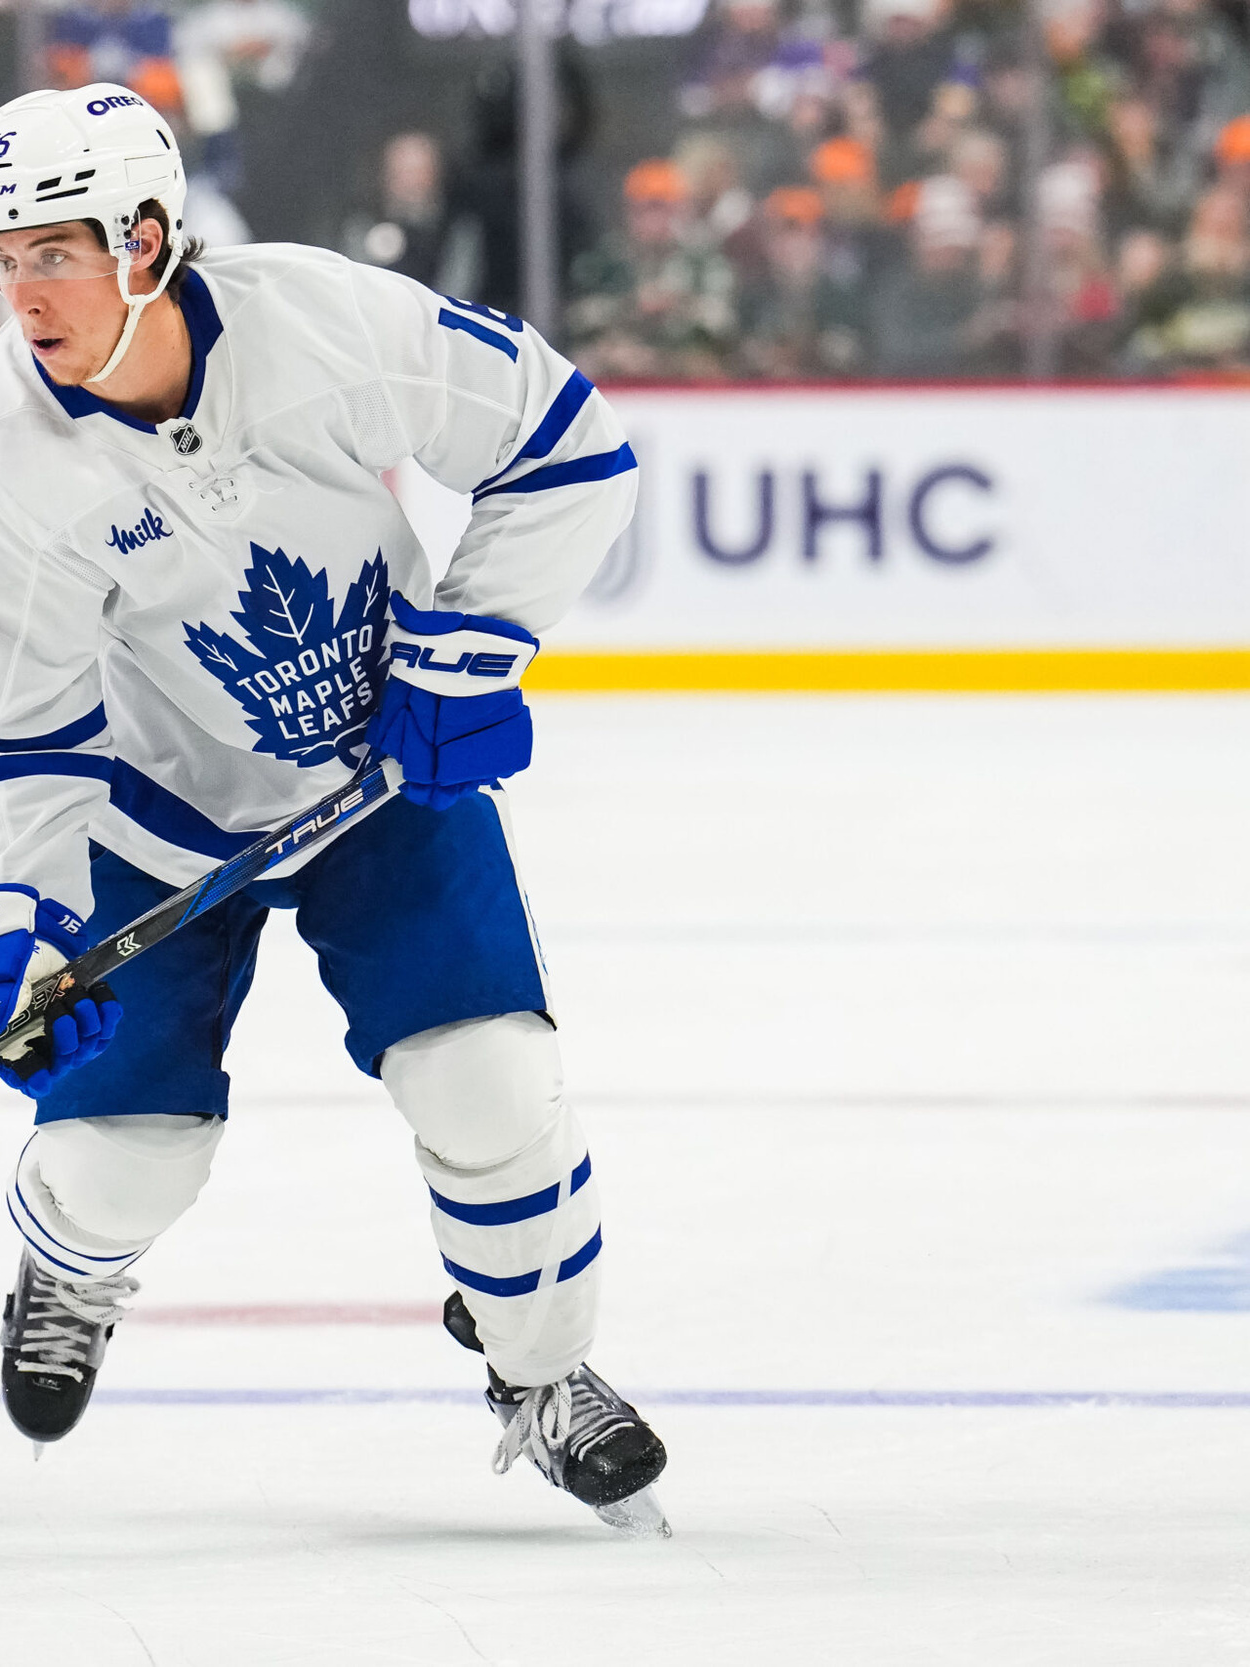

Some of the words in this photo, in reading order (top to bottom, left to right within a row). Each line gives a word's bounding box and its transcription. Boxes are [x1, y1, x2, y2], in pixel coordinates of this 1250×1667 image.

[691, 462, 996, 567] UHC
[236, 624, 374, 701] TORONTO
[268, 656, 368, 718] MAPLE
[389, 641, 519, 678] RUE
[278, 681, 374, 740] LEAFS
[264, 787, 364, 855] TRUE
[58, 914, 83, 934] 16
